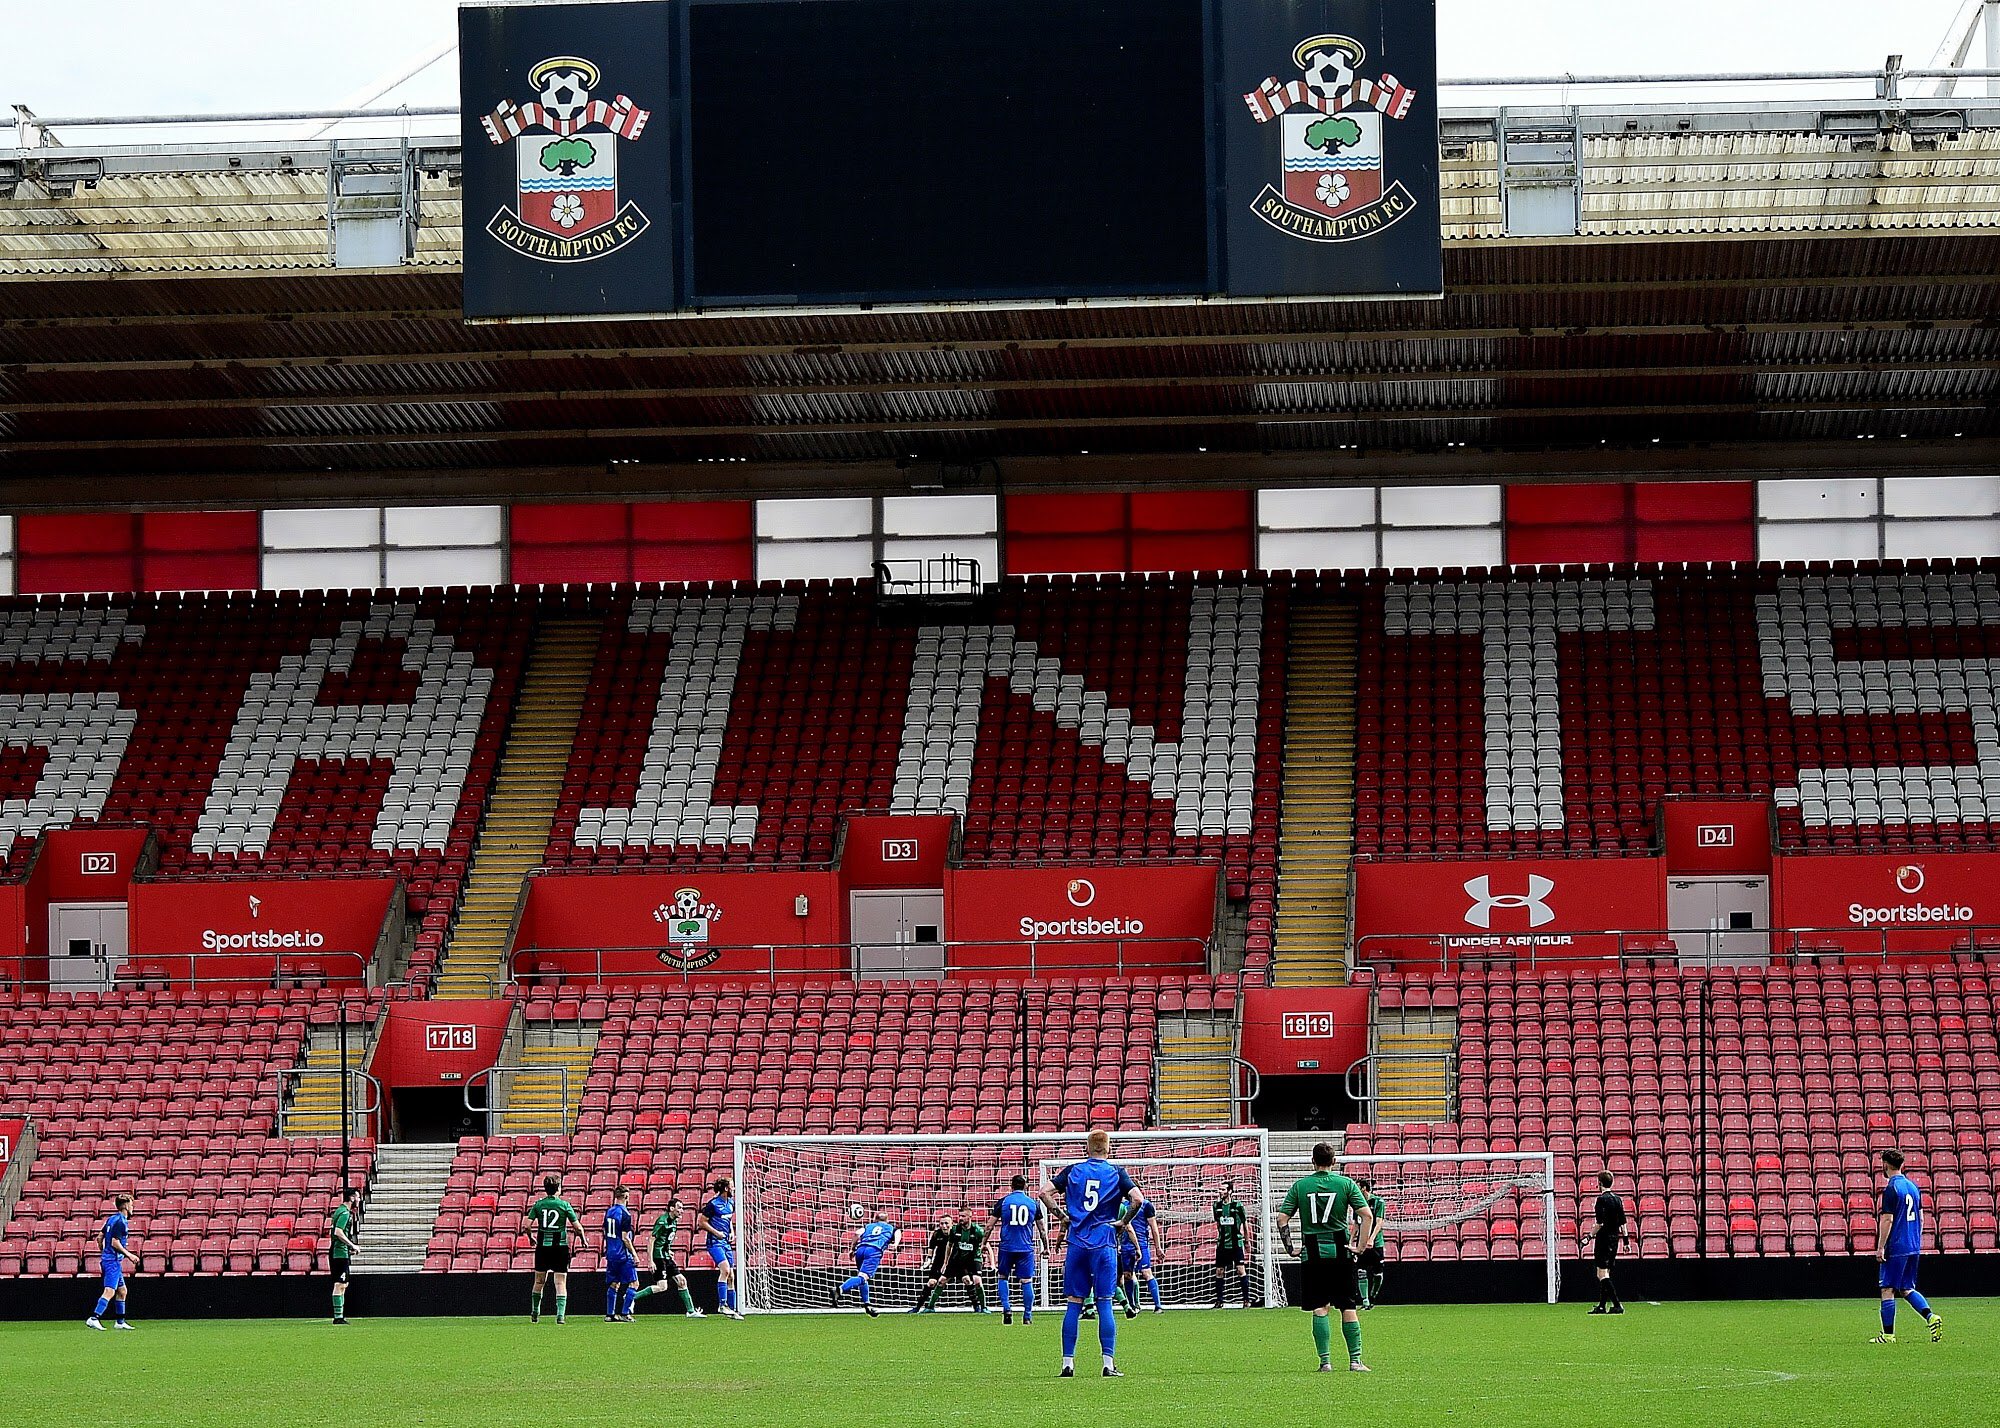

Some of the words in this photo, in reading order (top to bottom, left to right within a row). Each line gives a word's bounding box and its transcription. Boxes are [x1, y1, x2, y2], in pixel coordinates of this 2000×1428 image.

[1261, 198, 1382, 237] SOUTHAMPTON
[1380, 194, 1404, 219] FC
[497, 219, 616, 257] SOUTHAMPTON
[615, 214, 638, 239] FC
[1704, 828, 1727, 843] D4
[889, 842, 911, 857] D3
[88, 856, 110, 870] D2
[1848, 902, 1973, 927] Sportsbet.io
[1019, 915, 1144, 940] Sportsbet.io
[202, 929, 324, 953] Sportsbet.io
[1448, 937, 1501, 947] UNDER
[707, 951, 718, 962] FC
[1286, 1017, 1306, 1033] 18
[1309, 1017, 1329, 1033] 19
[429, 1030, 449, 1045] 17
[453, 1030, 472, 1045] 18
[1083, 1179, 1101, 1212] 5
[1009, 1204, 1029, 1226] 10
[1306, 1192, 1338, 1224] 17
[1905, 1193, 1916, 1222] 2
[541, 1209, 560, 1229] 12
[606, 1218, 617, 1239] 11
[340, 1272, 346, 1281] 4
